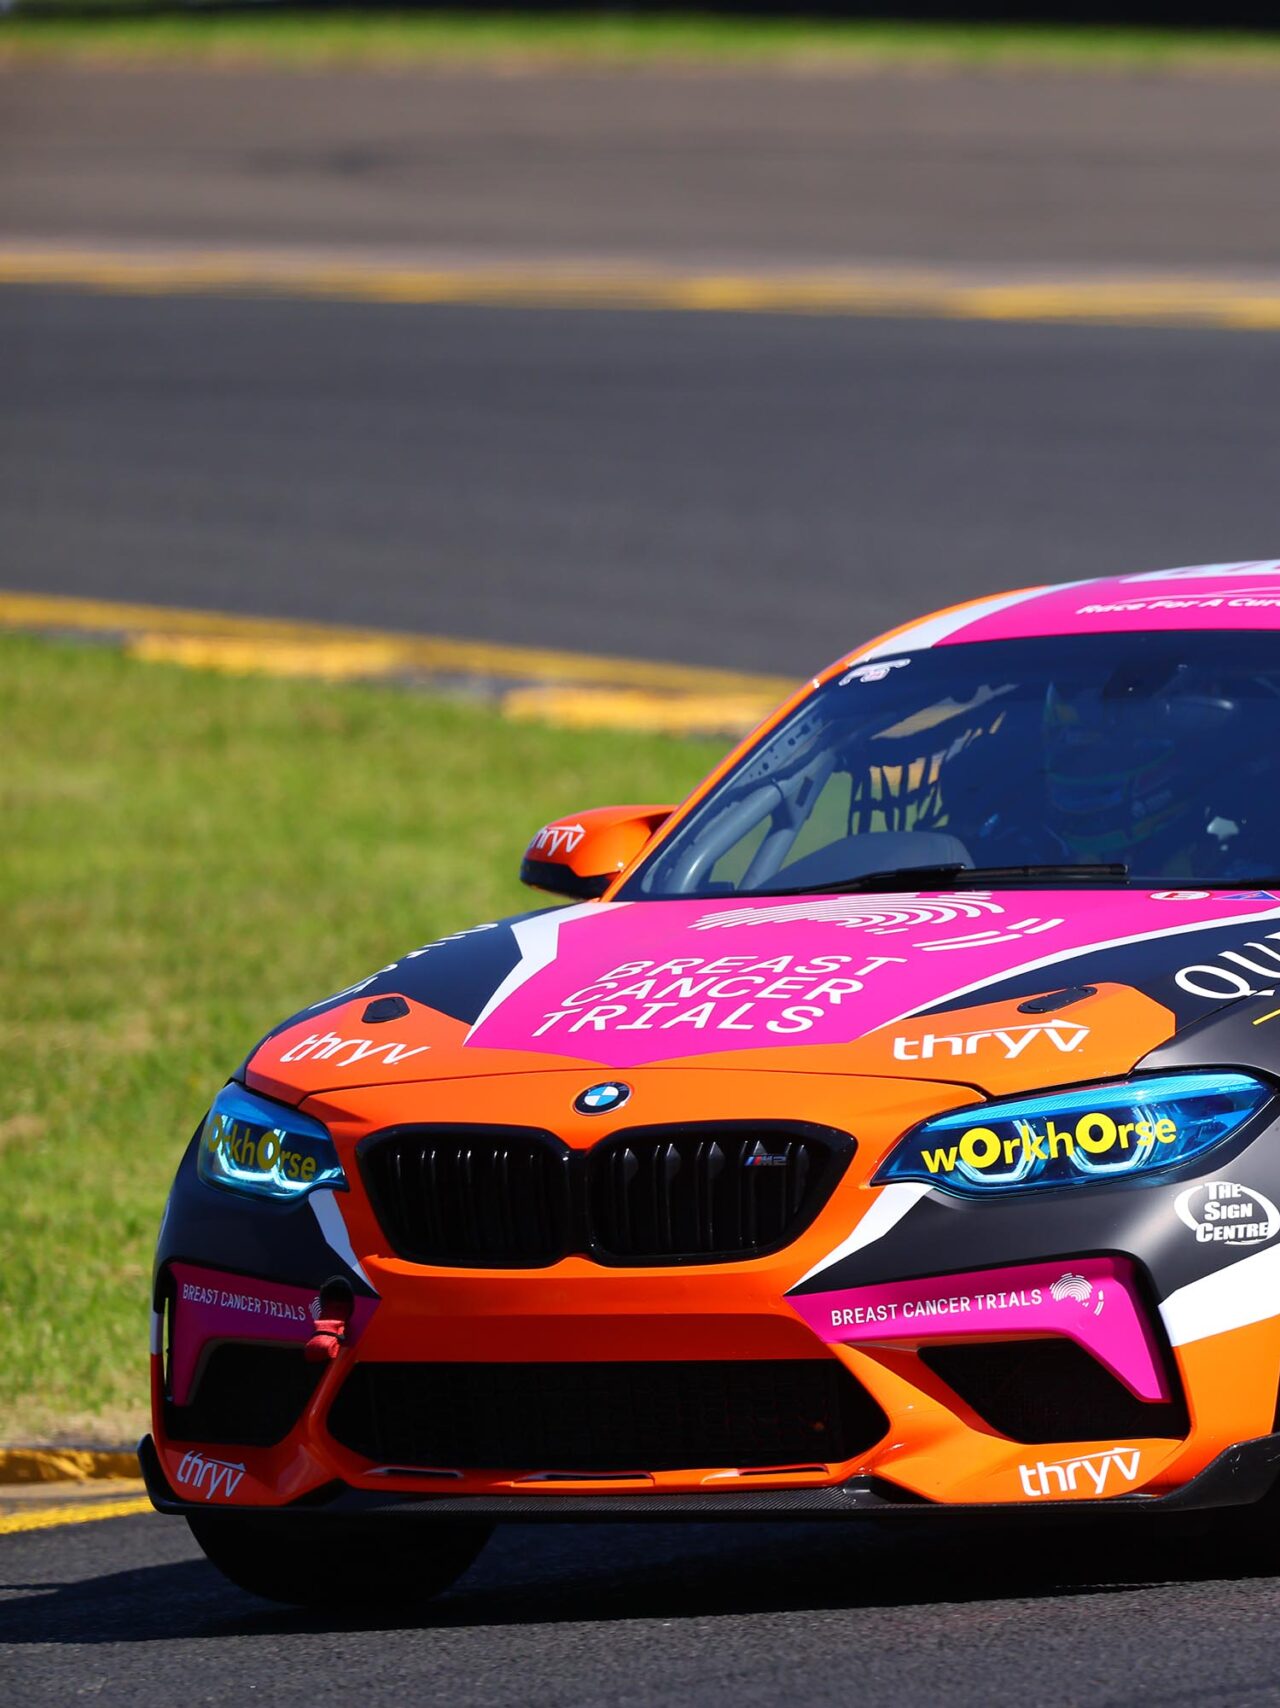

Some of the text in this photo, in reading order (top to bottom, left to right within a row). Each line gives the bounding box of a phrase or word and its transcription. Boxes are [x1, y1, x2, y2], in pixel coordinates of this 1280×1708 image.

[1148, 599, 1199, 610] For
[1200, 598, 1224, 608] A
[529, 826, 585, 857] hryv
[596, 955, 907, 983] BREAST
[561, 976, 863, 1007] CANCER
[531, 1003, 825, 1036] TRIALS
[280, 1032, 430, 1066] thryv
[893, 1026, 1090, 1060] thryv
[1205, 1183, 1242, 1200] THE
[1204, 1201, 1253, 1221] SIGN
[1196, 1222, 1269, 1242] CENTRE
[183, 1284, 306, 1321] BREAST CANCER TRIALS
[831, 1289, 1042, 1326] BREAST CANCER TRIALS
[177, 1451, 245, 1499] thryv
[1018, 1451, 1141, 1497] thryv
